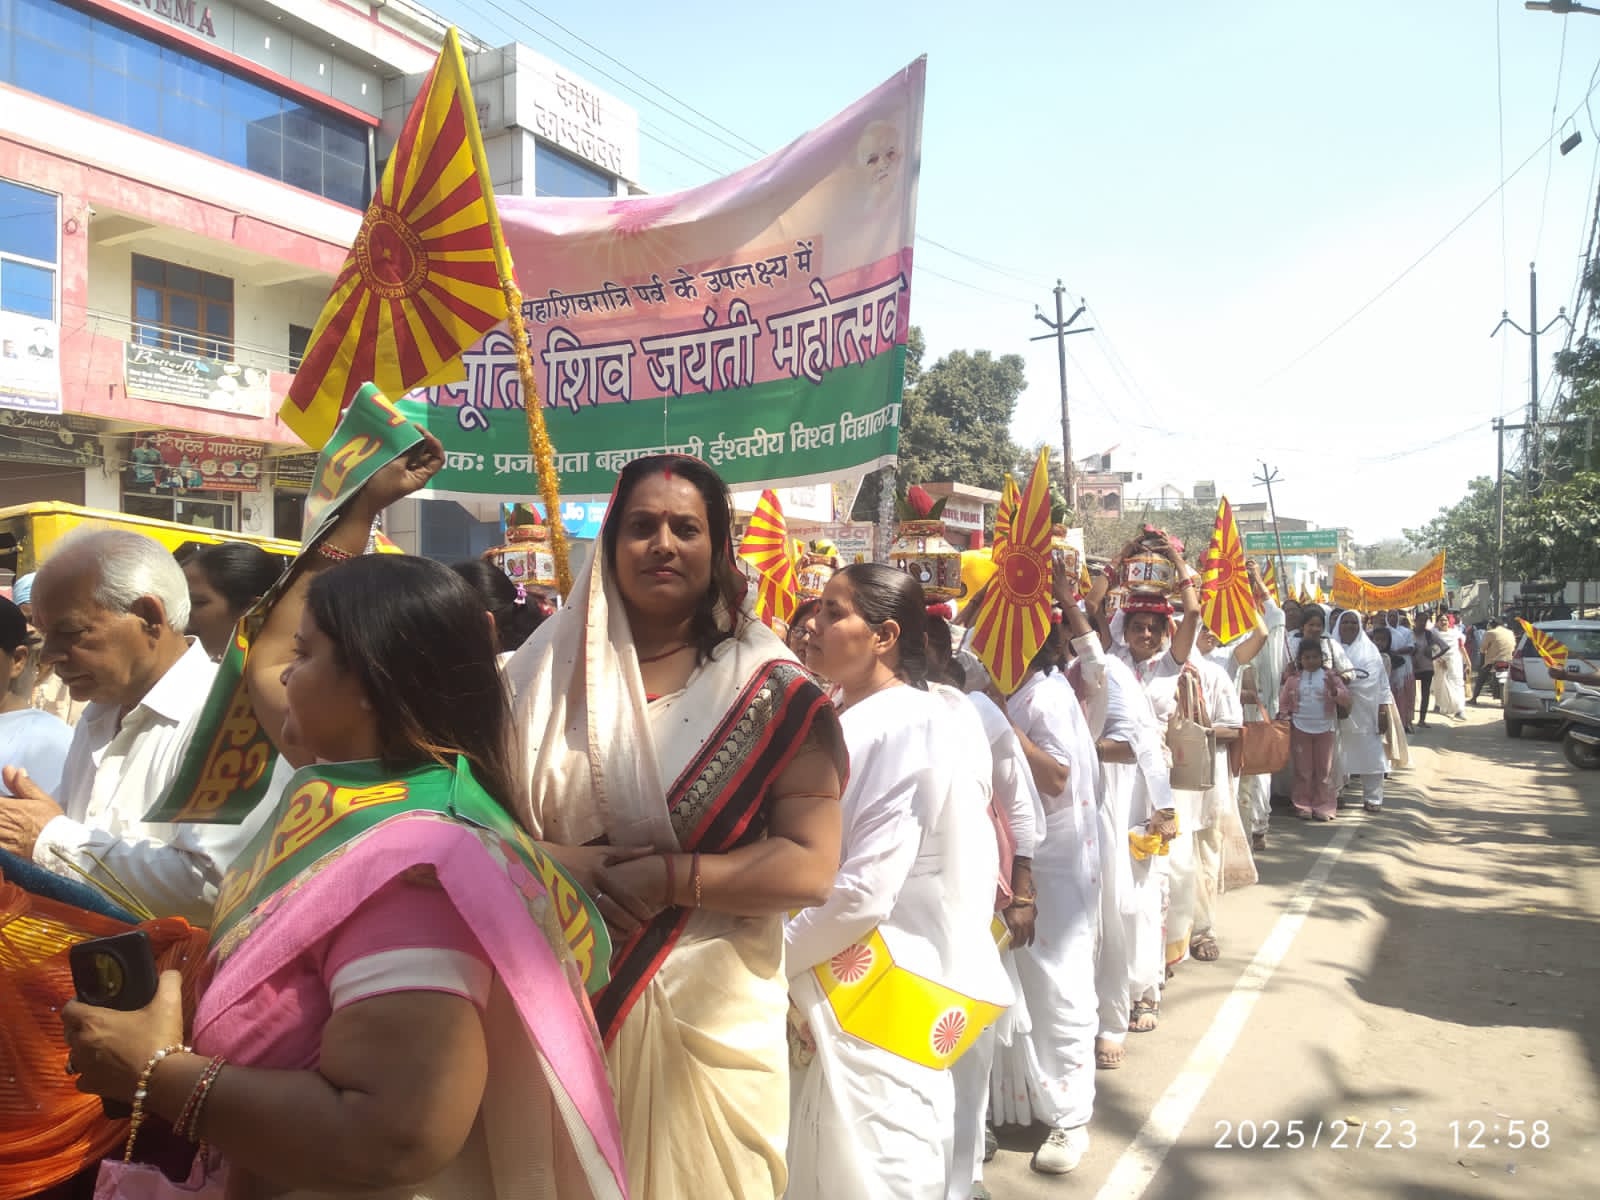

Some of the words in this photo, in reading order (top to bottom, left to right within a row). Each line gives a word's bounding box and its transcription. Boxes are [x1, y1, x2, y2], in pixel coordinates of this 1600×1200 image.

[521, 281, 632, 323] महाशिवरात्रि
[632, 274, 667, 305] पर्व
[669, 268, 698, 299] के
[701, 254, 788, 293] उपलक्ष्य
[793, 240, 814, 273] में
[541, 325, 636, 414] शिव
[640, 301, 762, 398] जयंती
[767, 271, 908, 385] महोत्सव
[708, 427, 785, 466] ईश्वरीय
[790, 421, 836, 453] विश्व
[840, 403, 902, 444] विद्यालय
